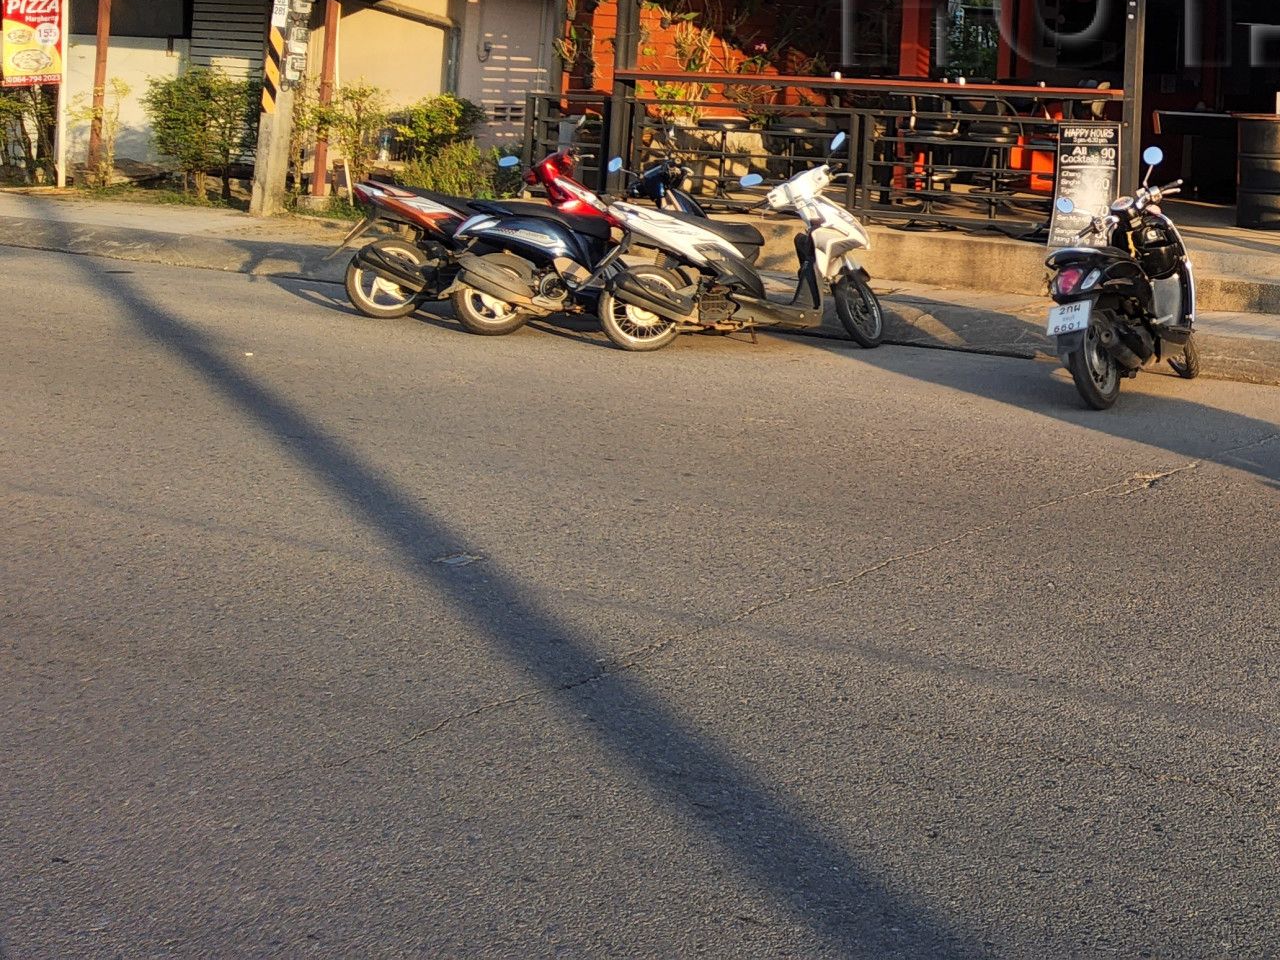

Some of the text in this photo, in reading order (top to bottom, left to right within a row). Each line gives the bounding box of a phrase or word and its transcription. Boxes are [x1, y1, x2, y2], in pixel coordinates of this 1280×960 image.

[1064, 128, 1115, 139] HAPPY HOURS
[1072, 146, 1088, 156] All
[1101, 147, 1116, 159] 90
